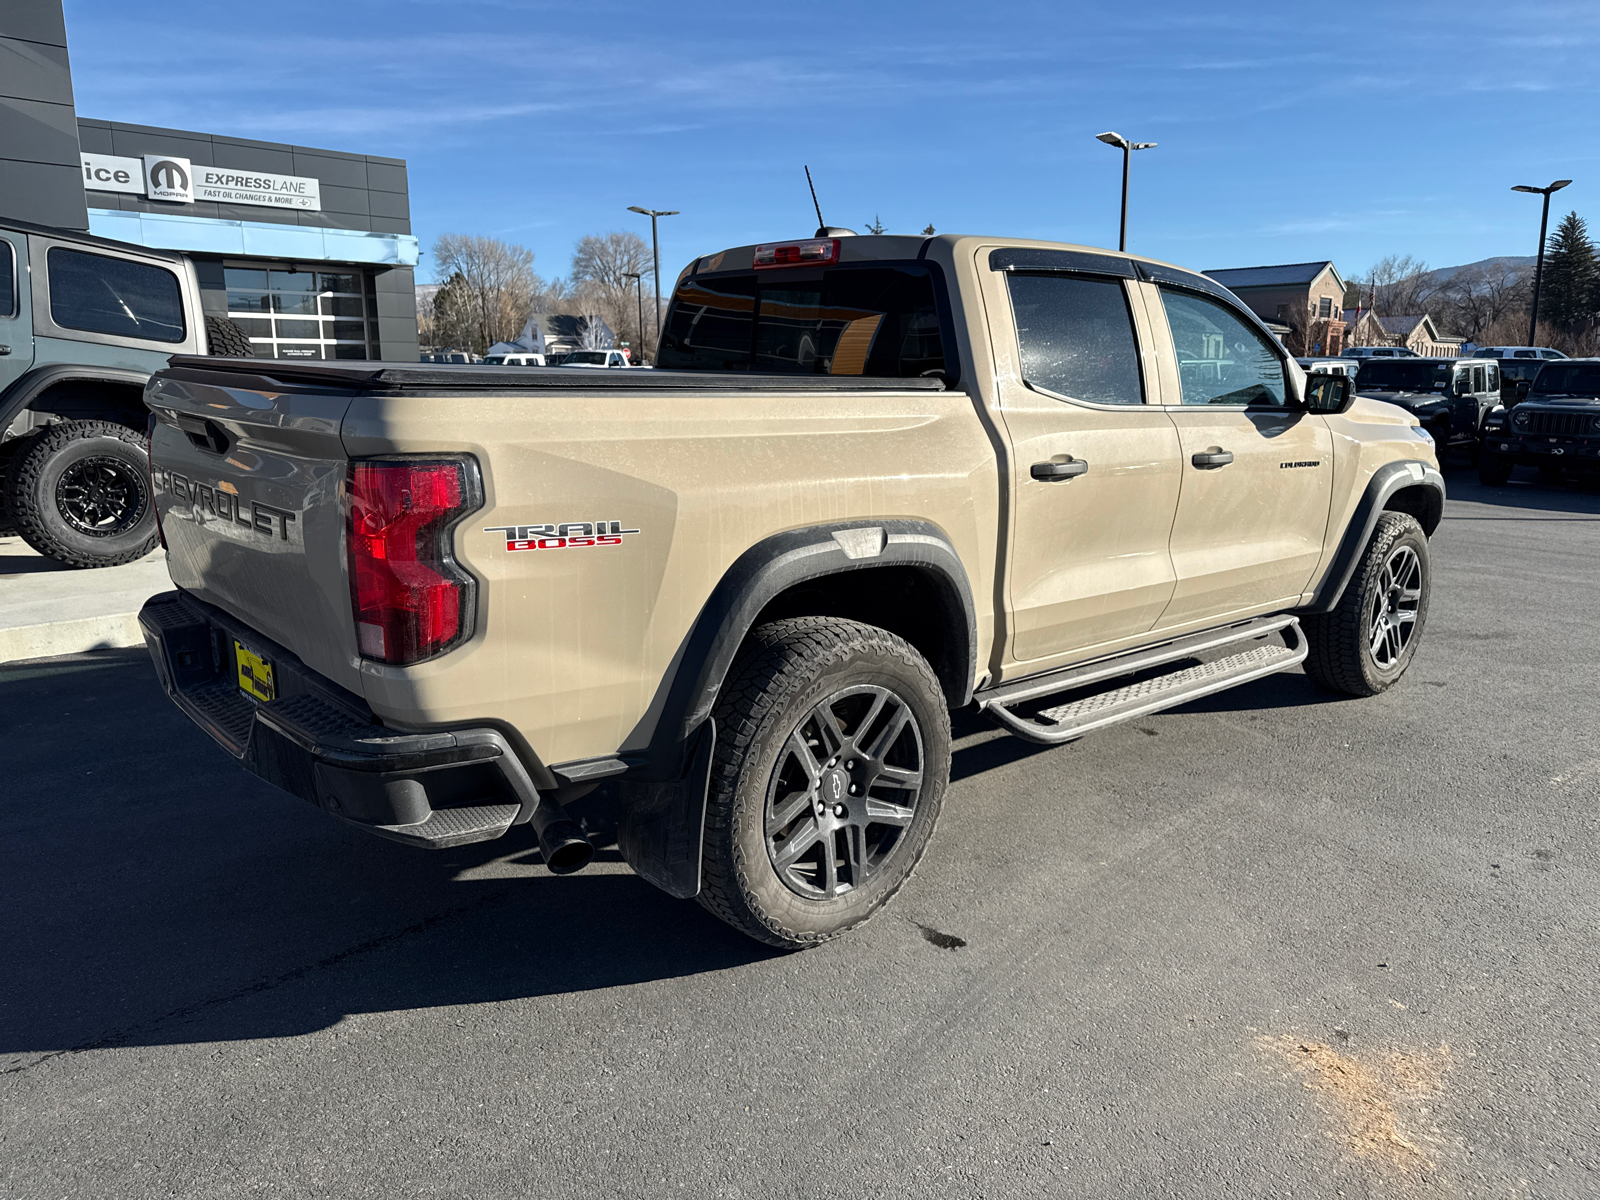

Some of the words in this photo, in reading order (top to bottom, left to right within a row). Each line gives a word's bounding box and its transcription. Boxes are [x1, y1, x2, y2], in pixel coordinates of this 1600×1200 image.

[84, 161, 131, 184] ice
[153, 190, 189, 199] MOPAR
[203, 189, 221, 198] FAST
[222, 190, 234, 200] OIL
[234, 192, 266, 203] CHANGES
[267, 195, 273, 203] &
[274, 196, 293, 205] MORE
[151, 462, 296, 541] CHEVROLET
[483, 520, 640, 540] TRAIL
[505, 534, 623, 552] BOSS
